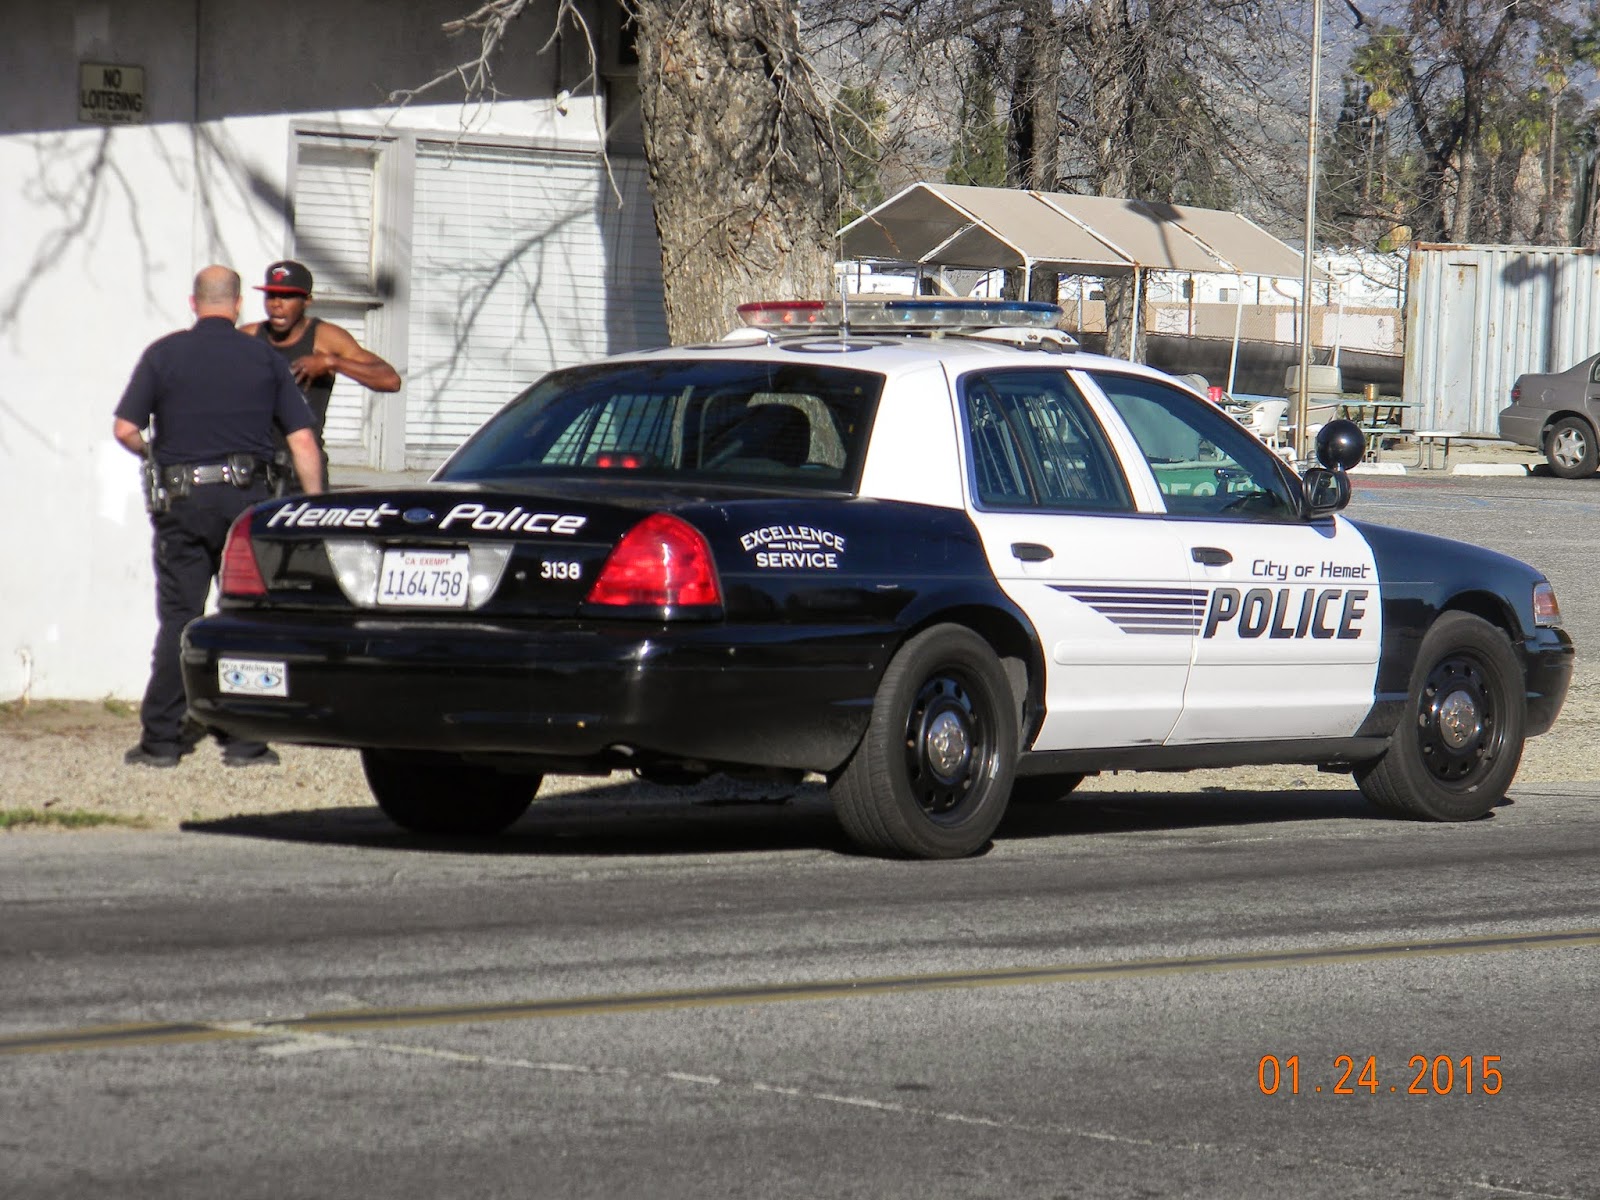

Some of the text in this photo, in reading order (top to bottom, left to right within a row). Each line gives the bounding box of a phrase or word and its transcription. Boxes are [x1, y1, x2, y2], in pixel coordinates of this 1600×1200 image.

[103, 69, 122, 89] NO
[82, 90, 142, 112] LOITERING
[267, 502, 588, 534] Hemet Police
[740, 525, 845, 552] EXCELLENCE
[405, 557, 451, 566] CA EXEMPT
[540, 561, 581, 580] 3138
[755, 552, 838, 568] SERVICE
[1252, 559, 1289, 581] City
[1320, 561, 1371, 579] Hemet
[384, 570, 463, 597] 1164758
[1203, 587, 1369, 639] POLICE
